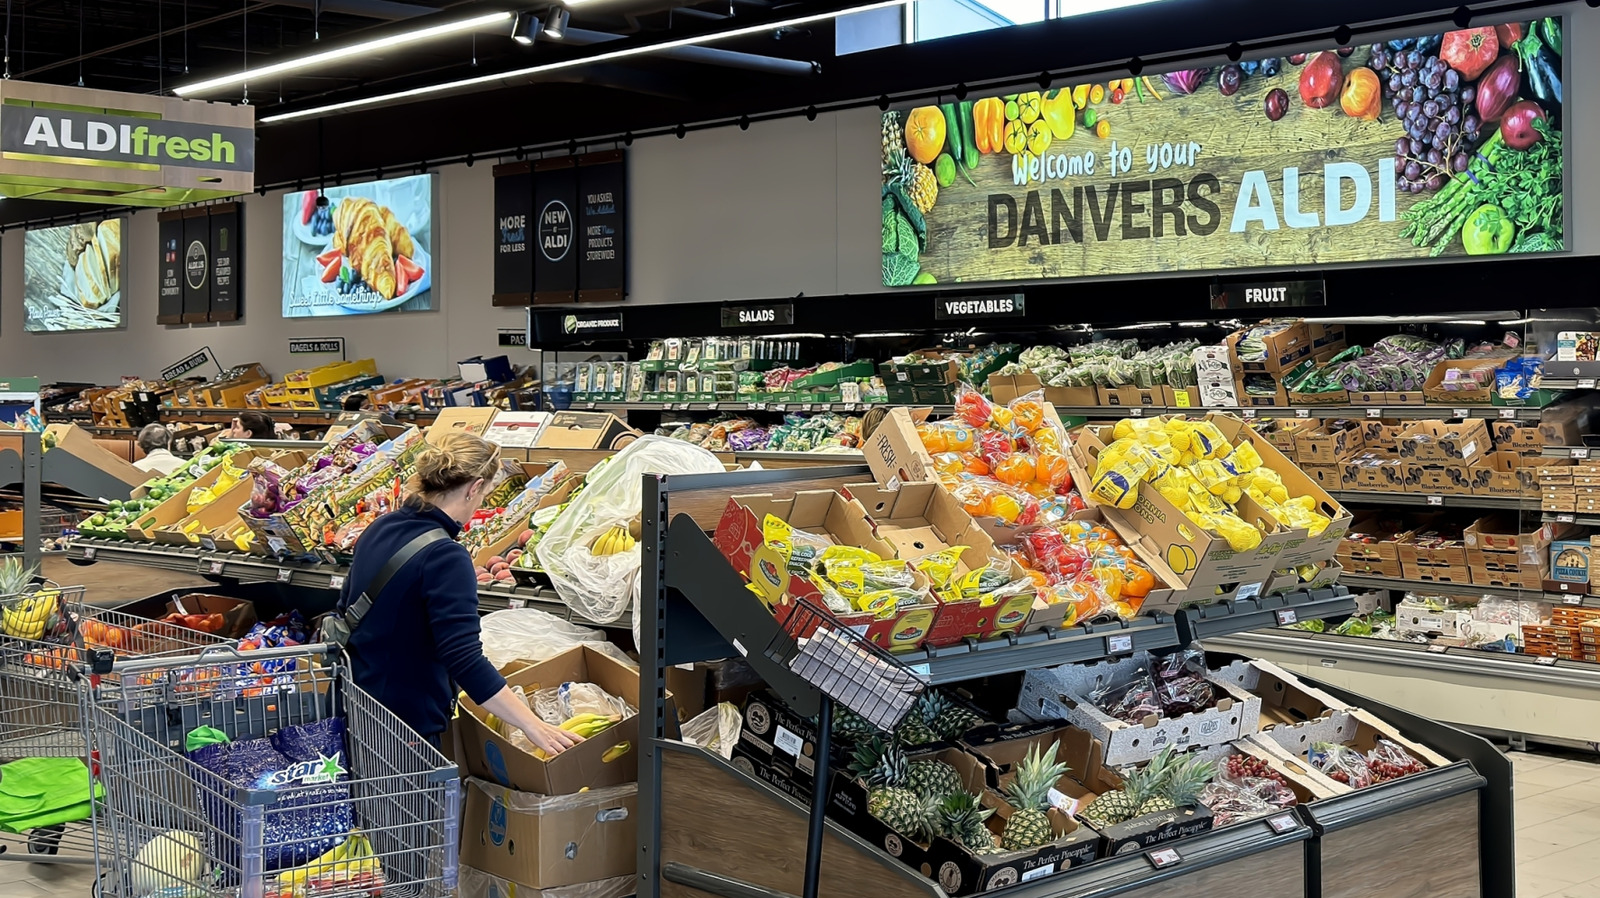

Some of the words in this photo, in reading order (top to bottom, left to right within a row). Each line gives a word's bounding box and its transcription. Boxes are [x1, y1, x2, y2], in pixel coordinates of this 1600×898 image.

[1012, 149, 1095, 186] Welcome
[1109, 140, 1132, 177] to
[1146, 140, 1200, 173] your
[987, 172, 1222, 249] DANVERS
[1229, 157, 1397, 232] ALDI
[500, 215, 526, 230] MORE
[544, 210, 566, 224] NEW
[501, 227, 525, 243] Fresh
[587, 226, 601, 236] MORE
[500, 244, 511, 253] FOR
[512, 243, 525, 252] LESS
[544, 234, 567, 248] ALDI
[588, 237, 613, 248] PRODUCTS
[289, 291, 313, 308] Sweet
[313, 290, 335, 306] Little
[336, 286, 383, 309] Somethings
[1245, 286, 1287, 303] FRUIT
[945, 298, 1014, 315] VEGETABLES
[577, 320, 598, 328] ORGANIC
[598, 319, 619, 327] PRODUCE
[739, 309, 775, 323] SALADS
[290, 343, 313, 352] BAGELS
[314, 343, 319, 351] &
[320, 342, 338, 351] ROLLS
[510, 335, 526, 345] PAS
[164, 365, 185, 381] BREAD
[188, 354, 206, 368] BUNS
[877, 434, 896, 468] FRESH
[1133, 503, 1154, 524] ONS
[1138, 494, 1167, 524] ORNIA
[774, 711, 786, 726] The
[785, 718, 805, 737] Perfect
[272, 760, 323, 784] star
[760, 766, 770, 780] The
[771, 772, 791, 793] Perfect
[1145, 835, 1157, 845] The
[1157, 829, 1178, 842] Perfect
[1023, 860, 1036, 870] The
[1037, 854, 1060, 867] Perfect
